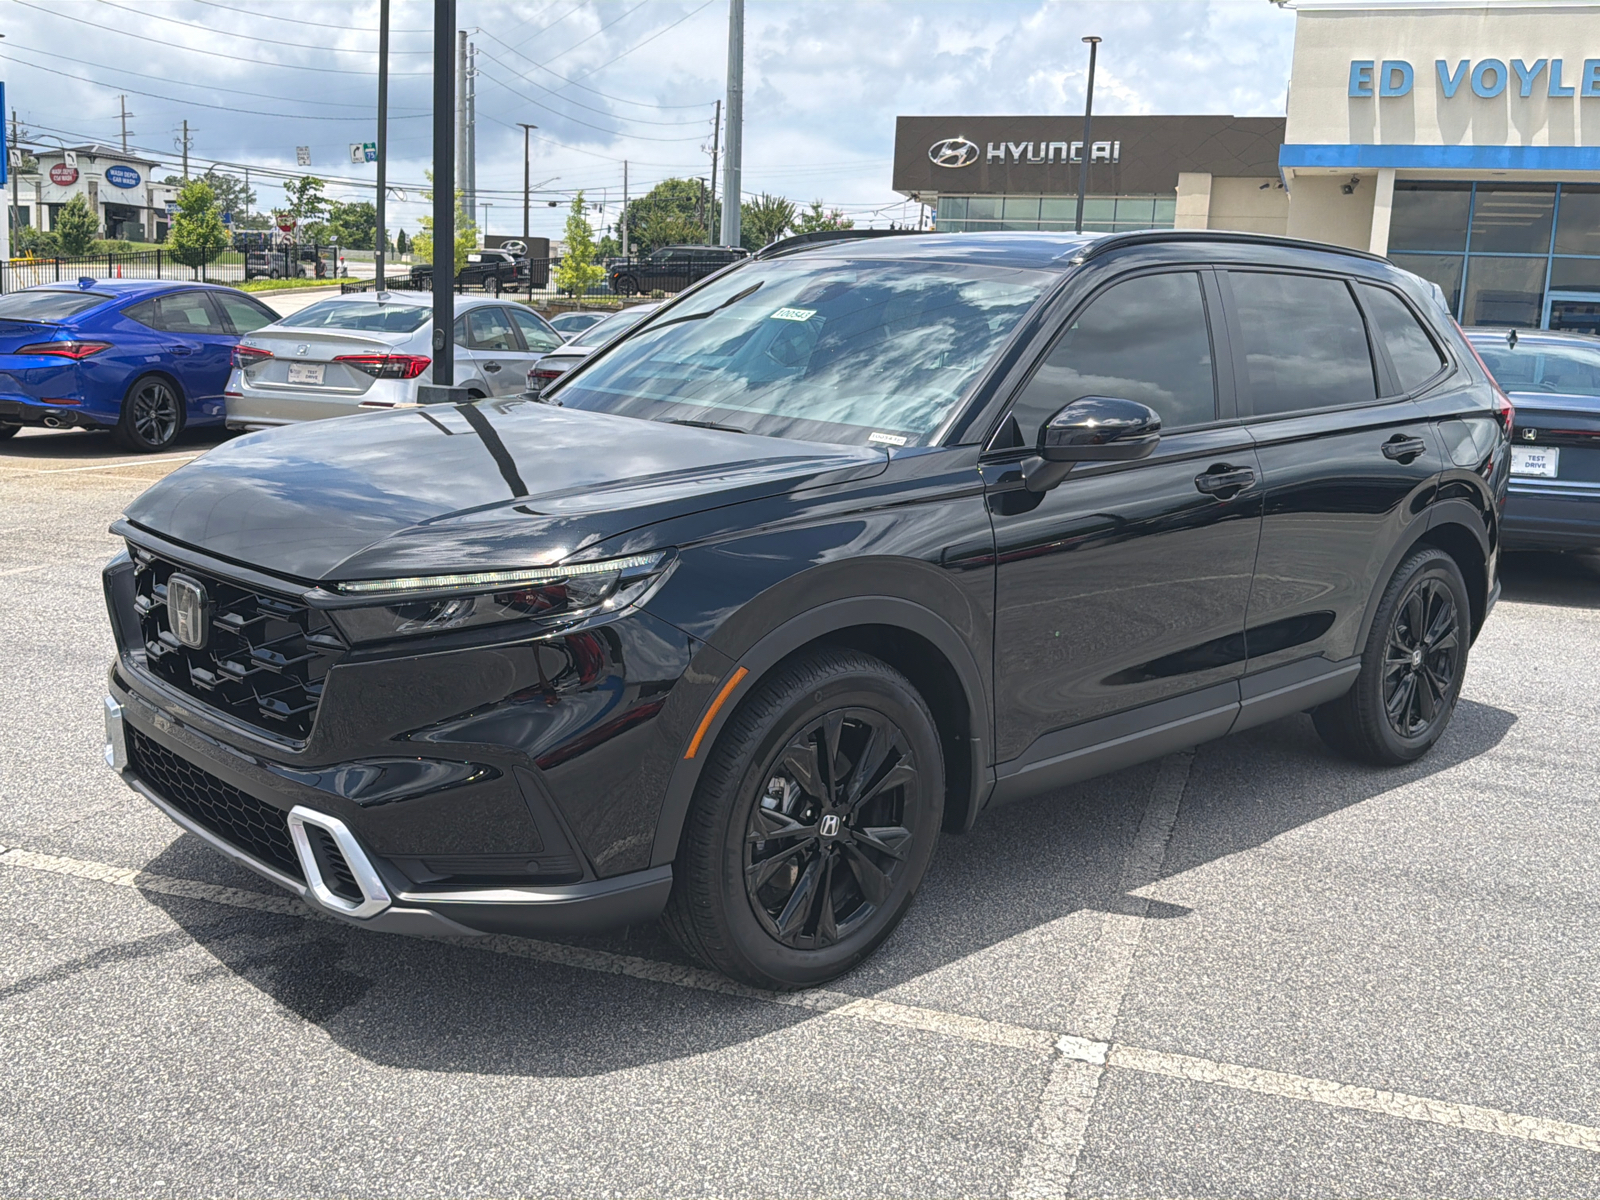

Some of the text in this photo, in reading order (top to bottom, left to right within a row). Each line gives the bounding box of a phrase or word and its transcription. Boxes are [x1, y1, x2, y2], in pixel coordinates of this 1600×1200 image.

[1348, 58, 1600, 98] ED VOYLE
[986, 141, 1121, 164] HYUNDAI
[110, 169, 124, 177] WASH
